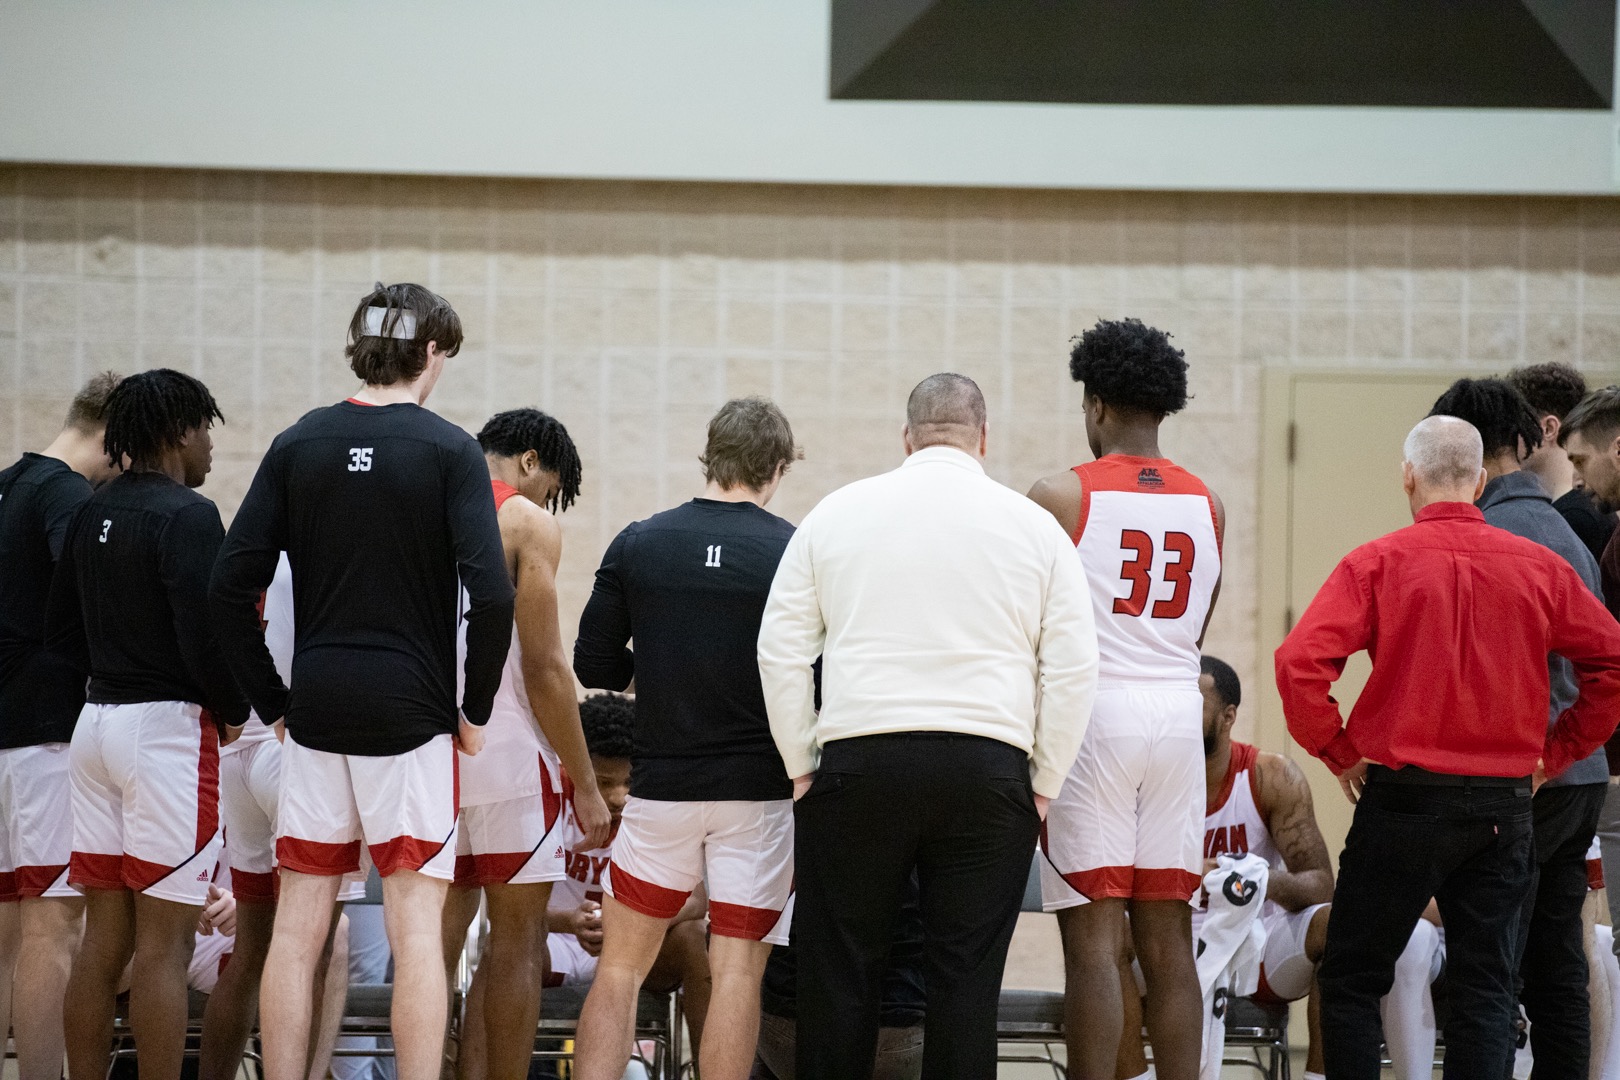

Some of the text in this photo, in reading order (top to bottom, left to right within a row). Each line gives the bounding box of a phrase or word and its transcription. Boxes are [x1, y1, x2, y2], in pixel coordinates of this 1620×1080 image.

[348, 447, 374, 472] 35
[99, 519, 113, 543] 3
[705, 545, 722, 568] 11
[1112, 528, 1195, 619] 33
